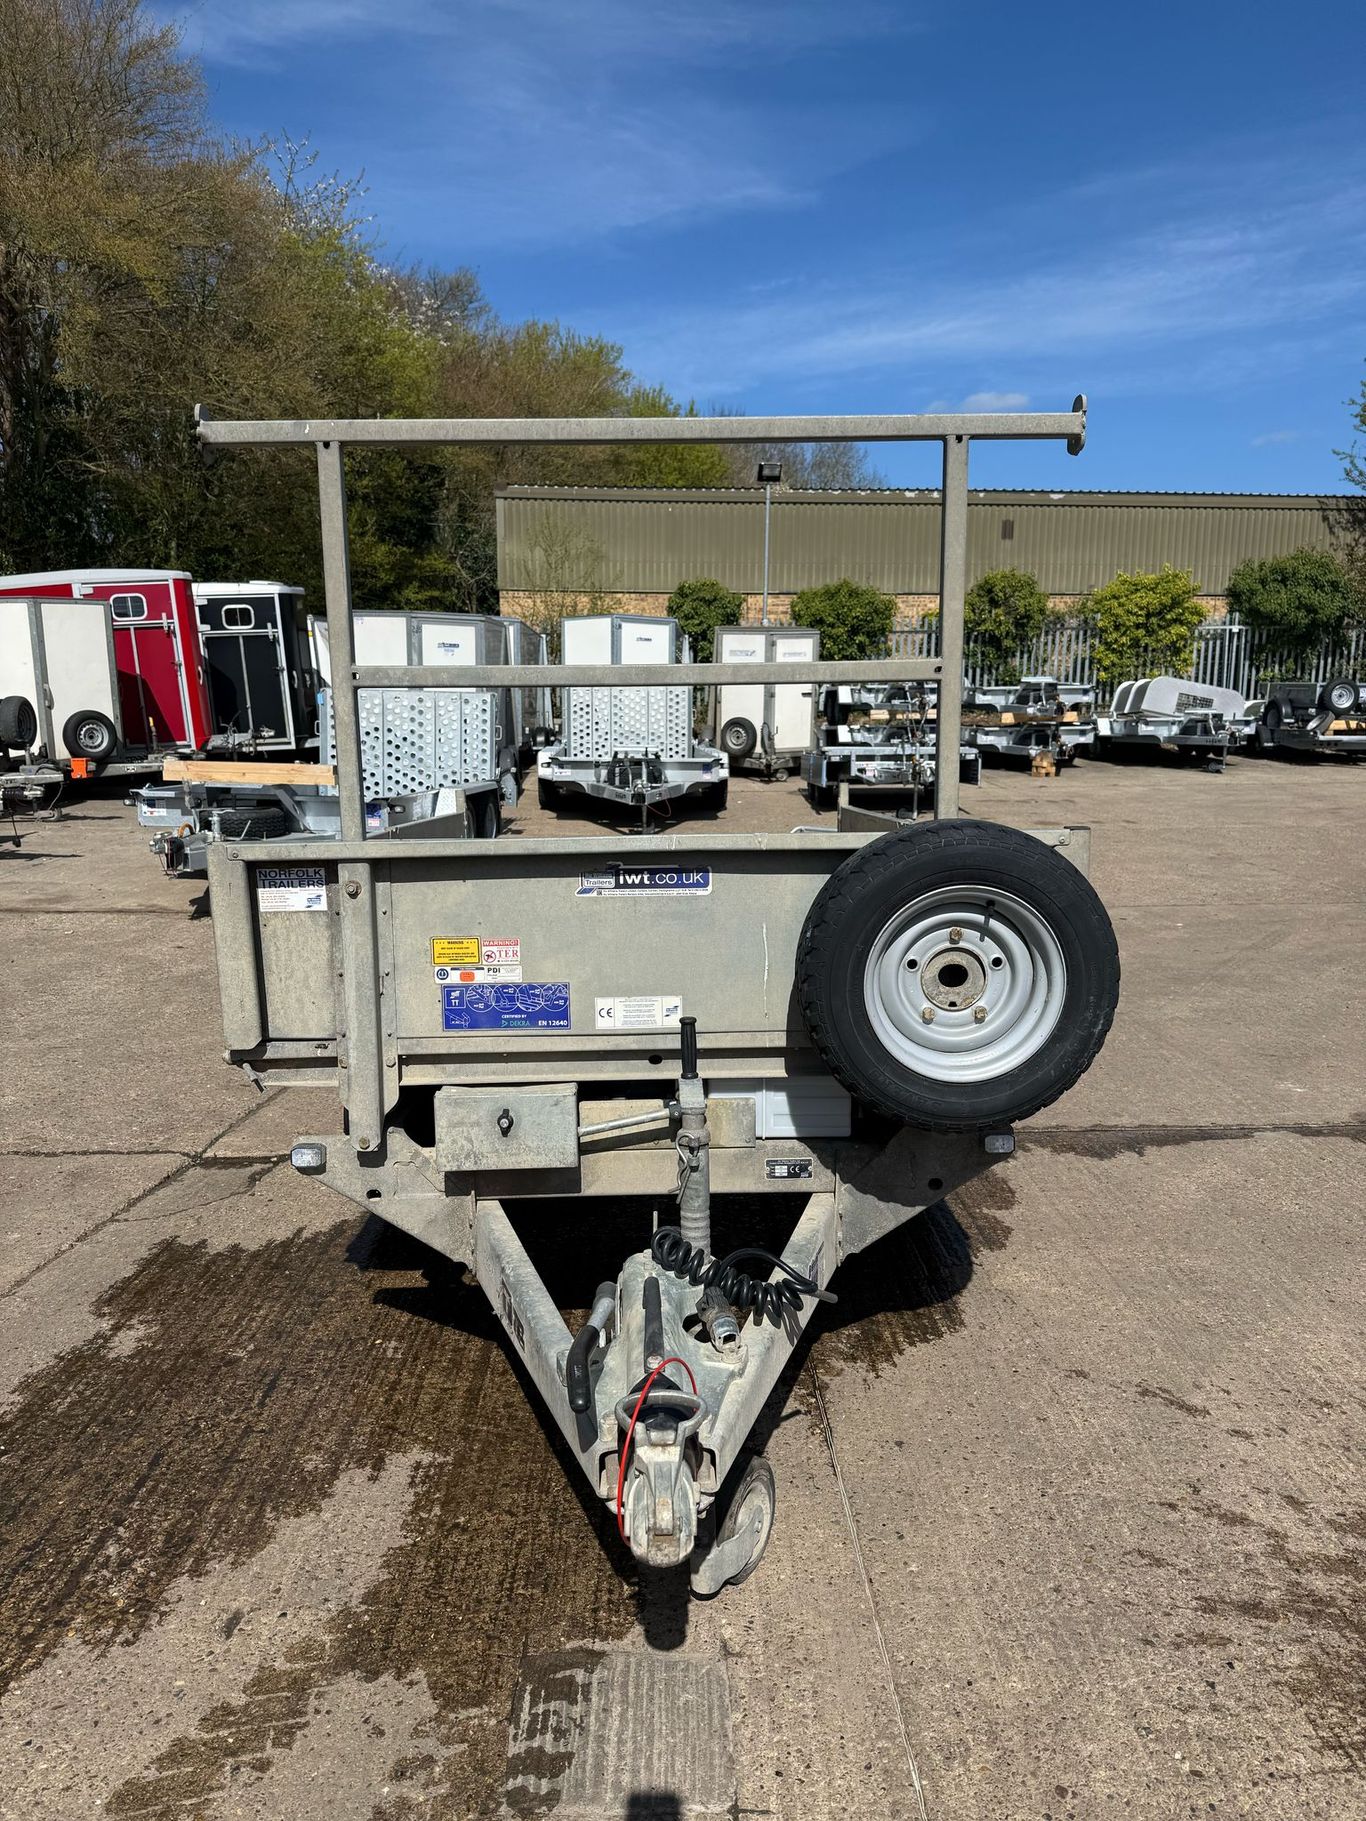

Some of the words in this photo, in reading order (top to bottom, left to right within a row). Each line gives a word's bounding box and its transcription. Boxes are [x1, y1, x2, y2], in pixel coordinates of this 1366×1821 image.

[258, 868, 322, 878] NORFOLK
[619, 870, 704, 885] iwt.co.uk
[259, 878, 325, 889] TRAILERS
